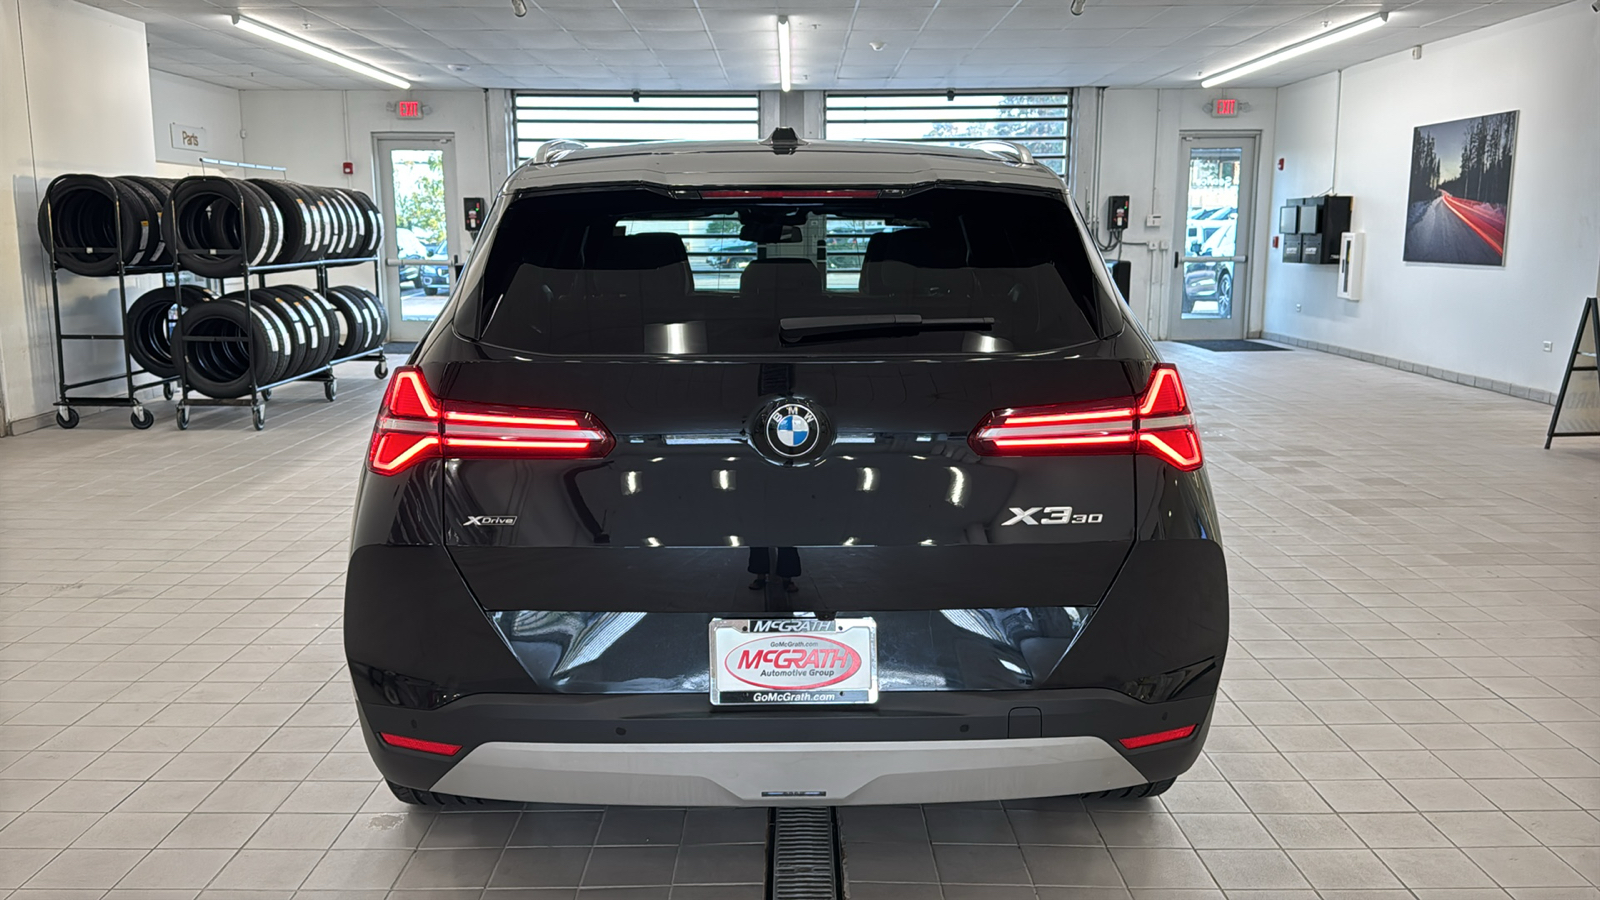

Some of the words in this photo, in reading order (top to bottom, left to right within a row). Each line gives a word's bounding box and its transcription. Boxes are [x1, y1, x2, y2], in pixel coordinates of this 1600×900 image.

[399, 101, 418, 117] EXIT
[1217, 99, 1235, 114] EXIT
[182, 130, 199, 146] Parts
[772, 406, 815, 423] BMW
[760, 669, 807, 677] Automotive
[809, 669, 835, 678] Group
[753, 692, 836, 702] GoMcGrath.com
